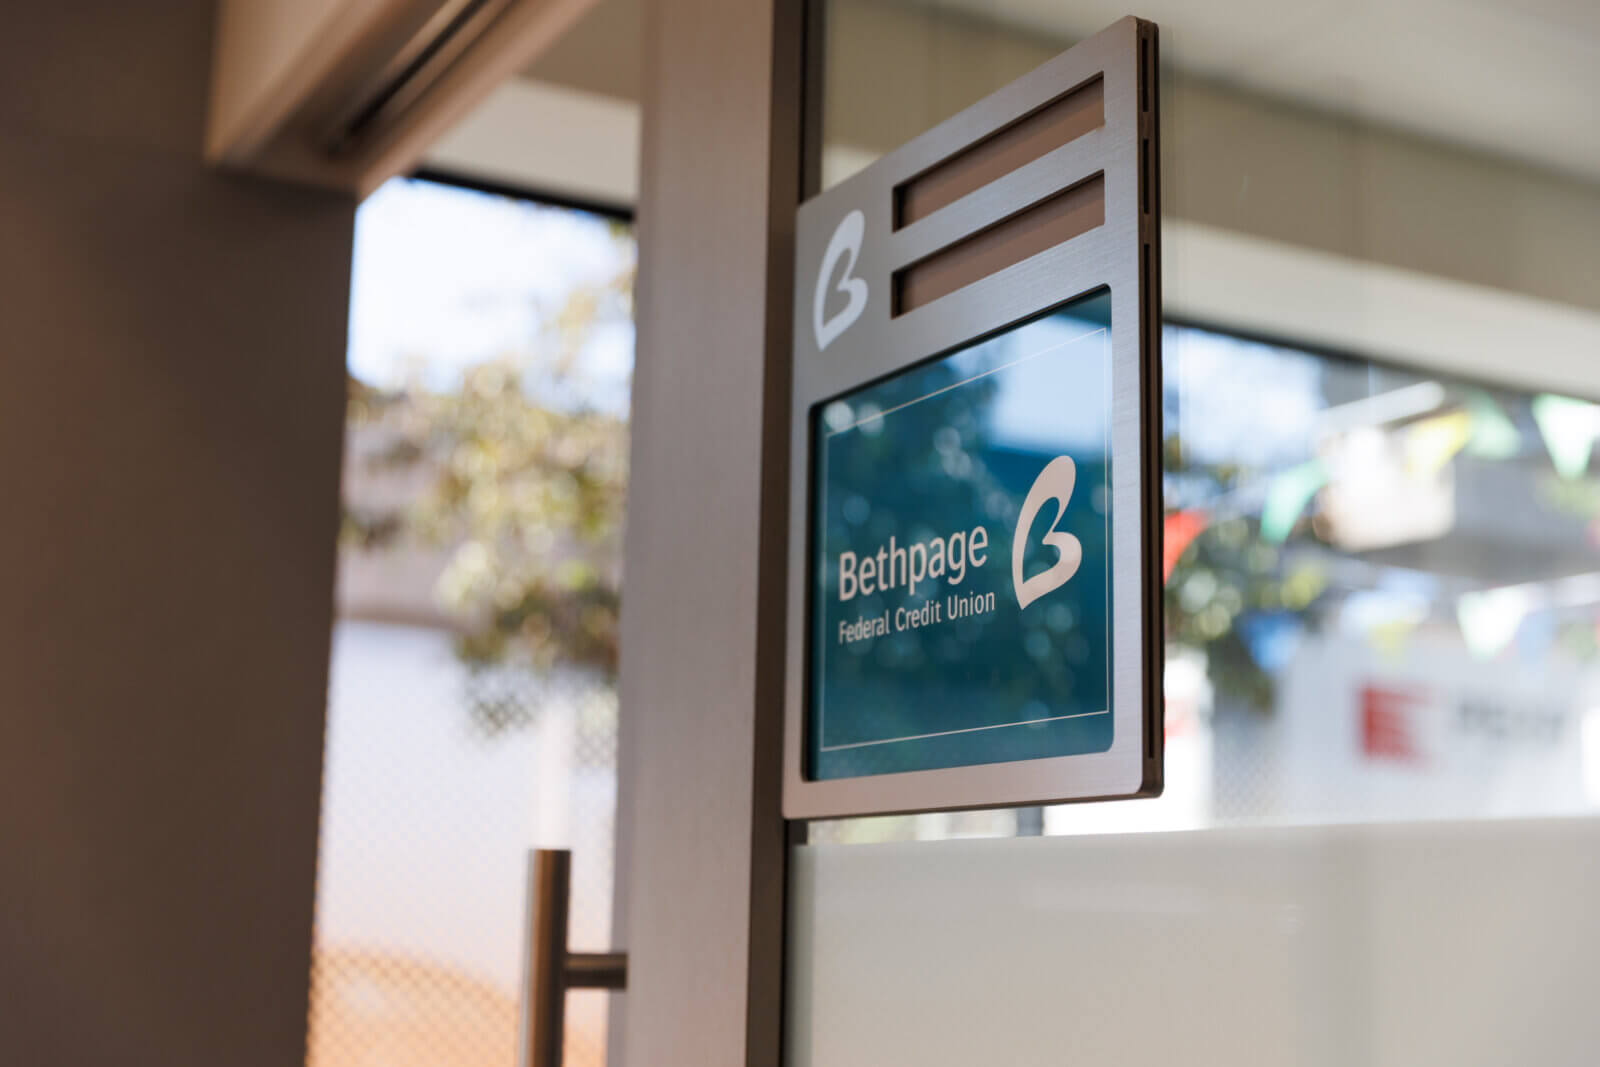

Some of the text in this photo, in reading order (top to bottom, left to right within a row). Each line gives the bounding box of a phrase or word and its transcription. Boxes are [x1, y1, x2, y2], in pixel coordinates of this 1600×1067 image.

[839, 525, 989, 602] Bethpage
[838, 591, 996, 645] Federal Credit Union
